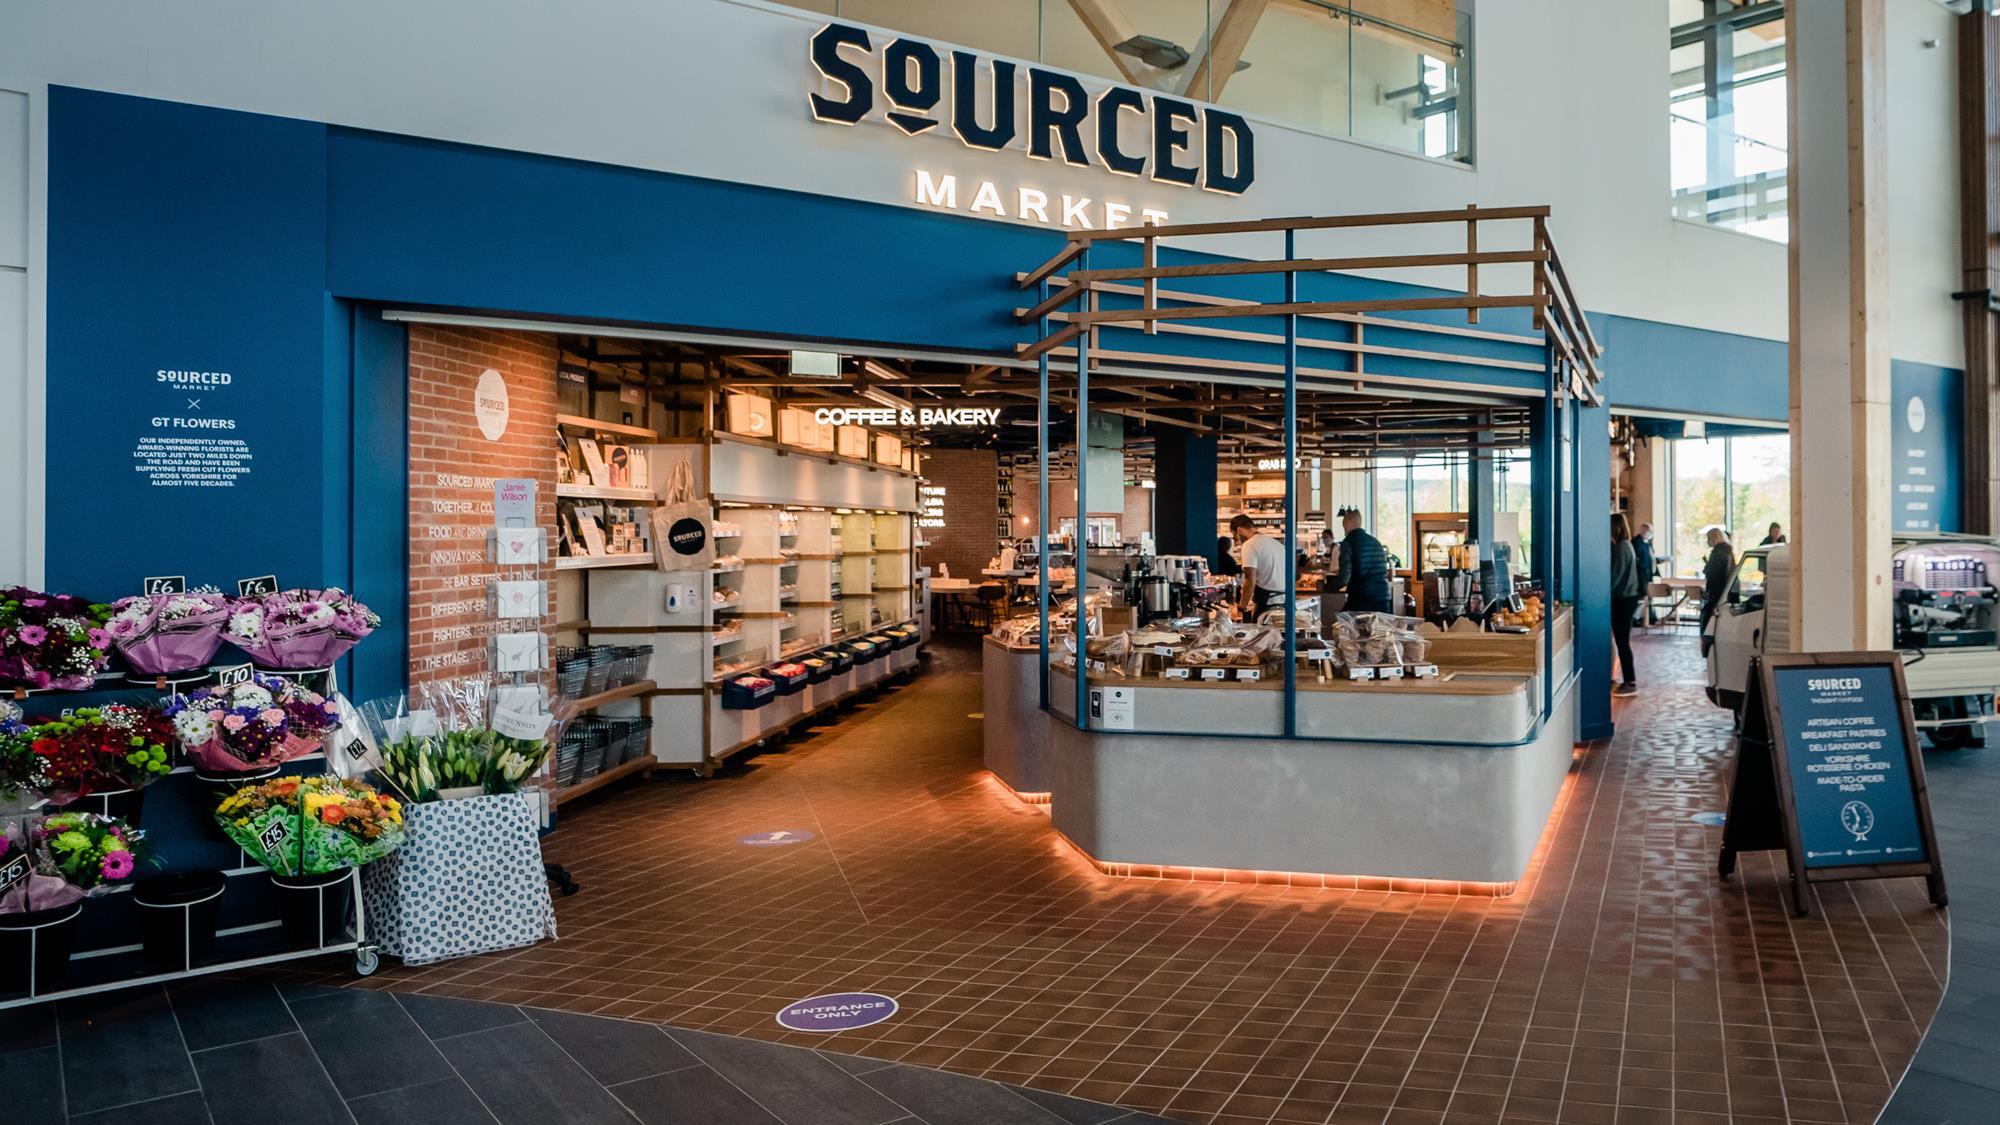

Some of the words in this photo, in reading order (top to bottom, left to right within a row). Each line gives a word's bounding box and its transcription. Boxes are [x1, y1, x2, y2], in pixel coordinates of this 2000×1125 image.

[809, 22, 1255, 196] SOURCED
[915, 170, 1169, 236] MARKET
[157, 369, 232, 385] SOURCED
[151, 417, 170, 427] GT
[173, 417, 236, 429] FLOWERS
[814, 408, 896, 425] COFFEE
[900, 408, 916, 425] &
[920, 408, 1001, 425] BAKERY
[437, 474, 473, 488] SOURCED
[473, 476, 496, 489] MARK
[503, 482, 526, 492] Janie
[501, 492, 528, 501] Wilson
[429, 526, 452, 538] FOOD
[673, 530, 703, 543] SOURCED
[151, 579, 174, 594] £6
[454, 574, 470, 588] BAR
[244, 581, 266, 596] £6
[425, 657, 442, 670] THE
[224, 668, 248, 687] £10
[1808, 678, 1862, 691] SOURCED
[1807, 718, 1842, 727] ARTISAN
[1842, 716, 1875, 726] COFFEE
[1801, 731, 1848, 740] BREAKFAST
[1848, 729, 1887, 738] PASTRIES
[1809, 743, 1827, 752] DELI
[1828, 741, 1882, 751] SANDWICHES
[1824, 754, 1871, 763] YORKSHIRE
[1807, 763, 1853, 772] ROTISSERIE
[1853, 762, 1891, 771] CHICKEN
[1839, 783, 1866, 792] PASTA
[266, 824, 283, 849] £15
[0, 860, 23, 888] £15
[790, 1002, 886, 1015] ENTRANCE
[814, 1010, 861, 1019] ONLY
